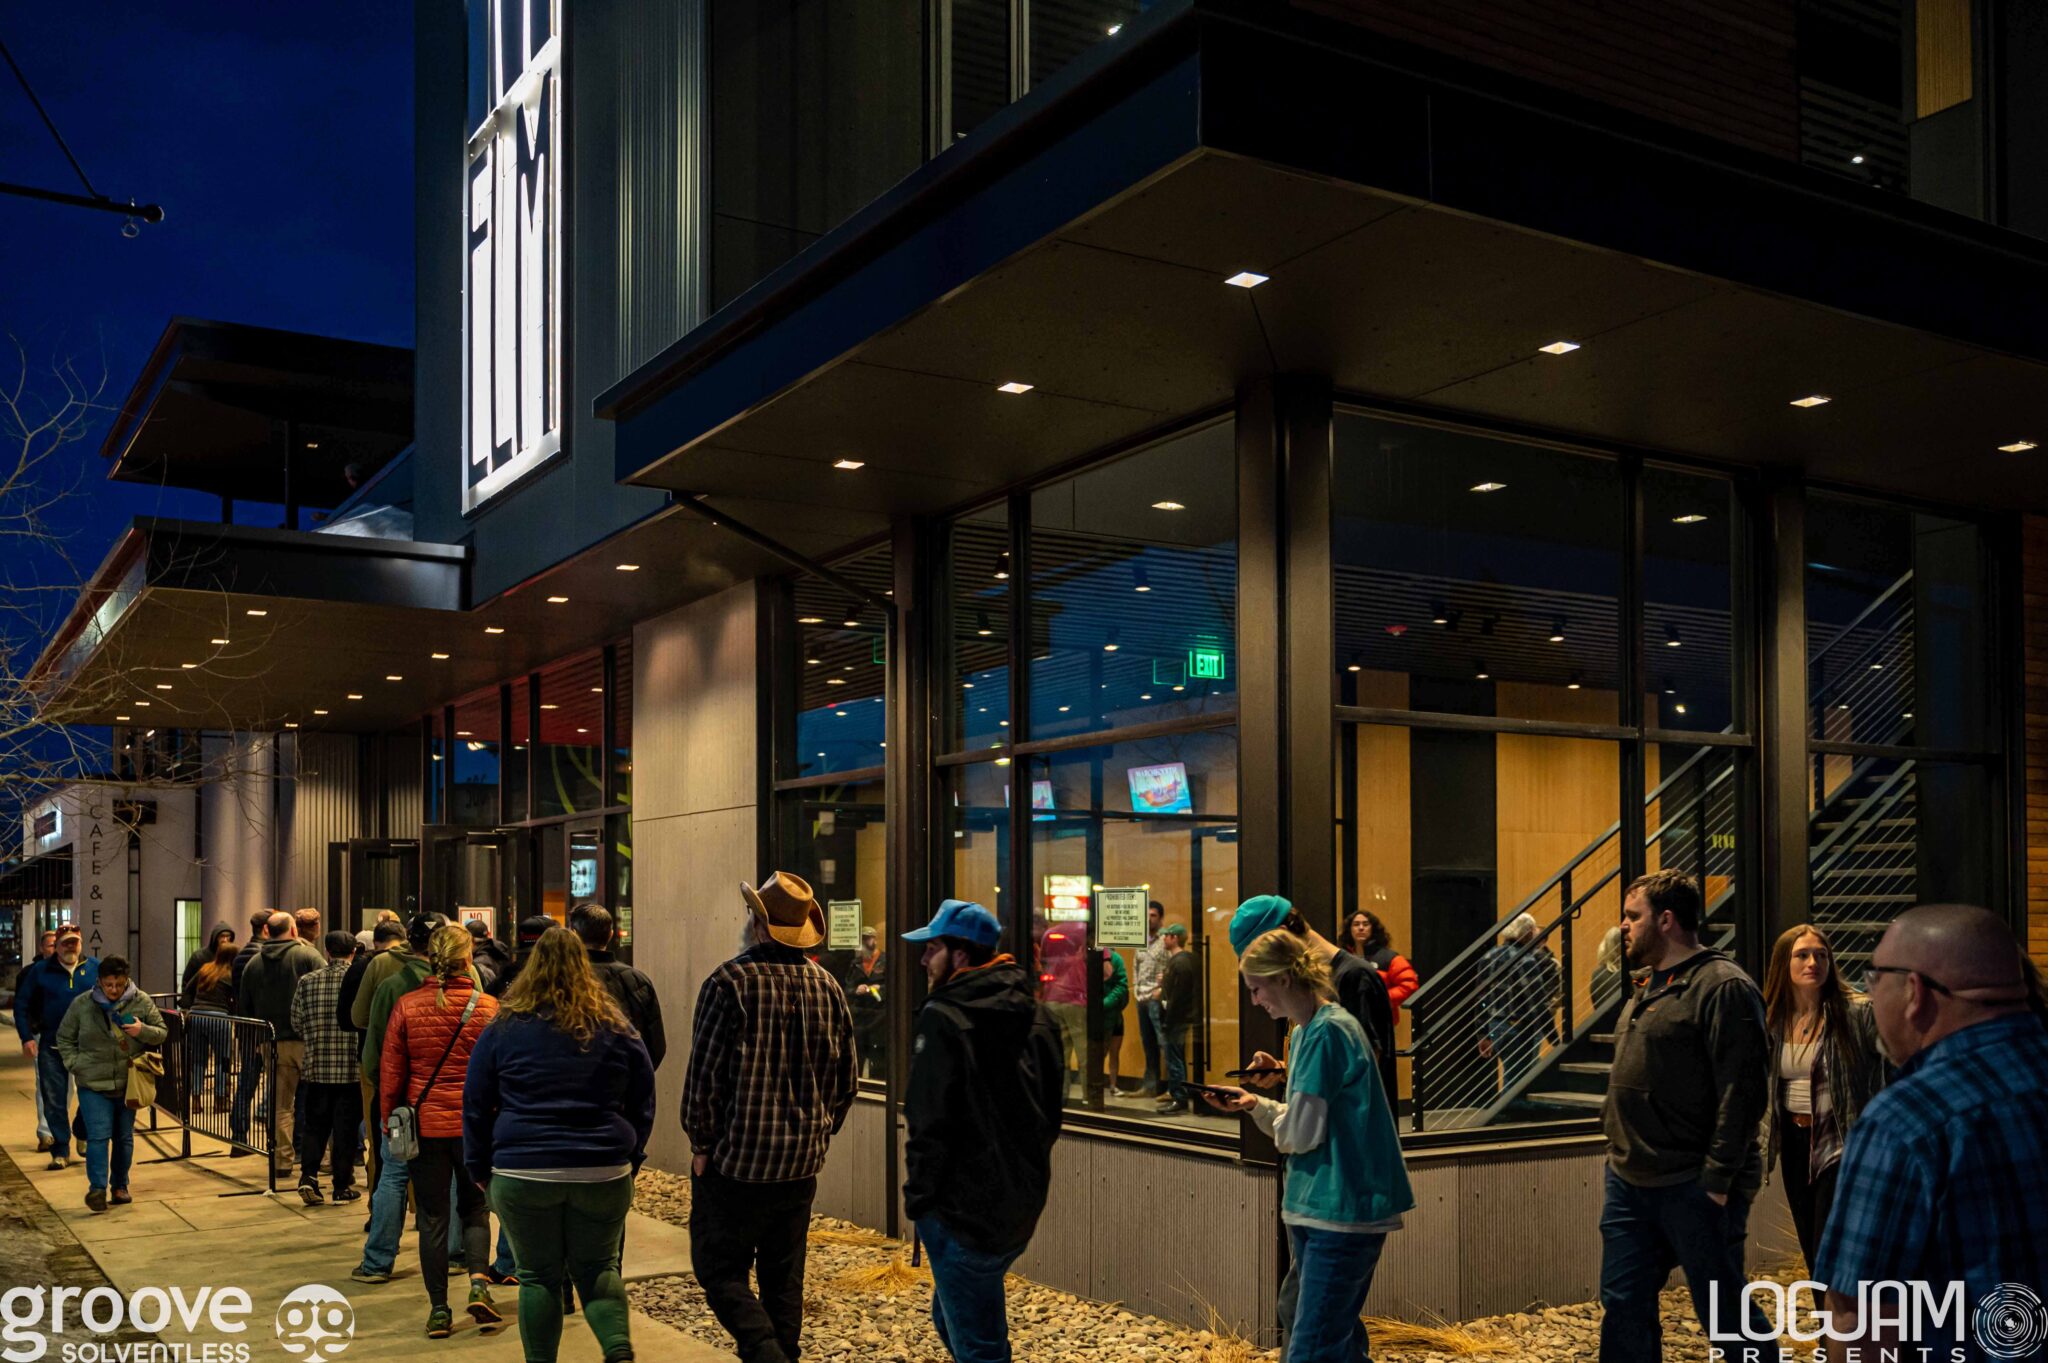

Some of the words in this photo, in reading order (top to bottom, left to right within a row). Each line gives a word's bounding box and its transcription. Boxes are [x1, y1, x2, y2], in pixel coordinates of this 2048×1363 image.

[1196, 653, 1219, 677] EXIT
[89, 804, 103, 875] CAFE
[90, 885, 102, 900] &
[469, 912, 483, 921] NO
